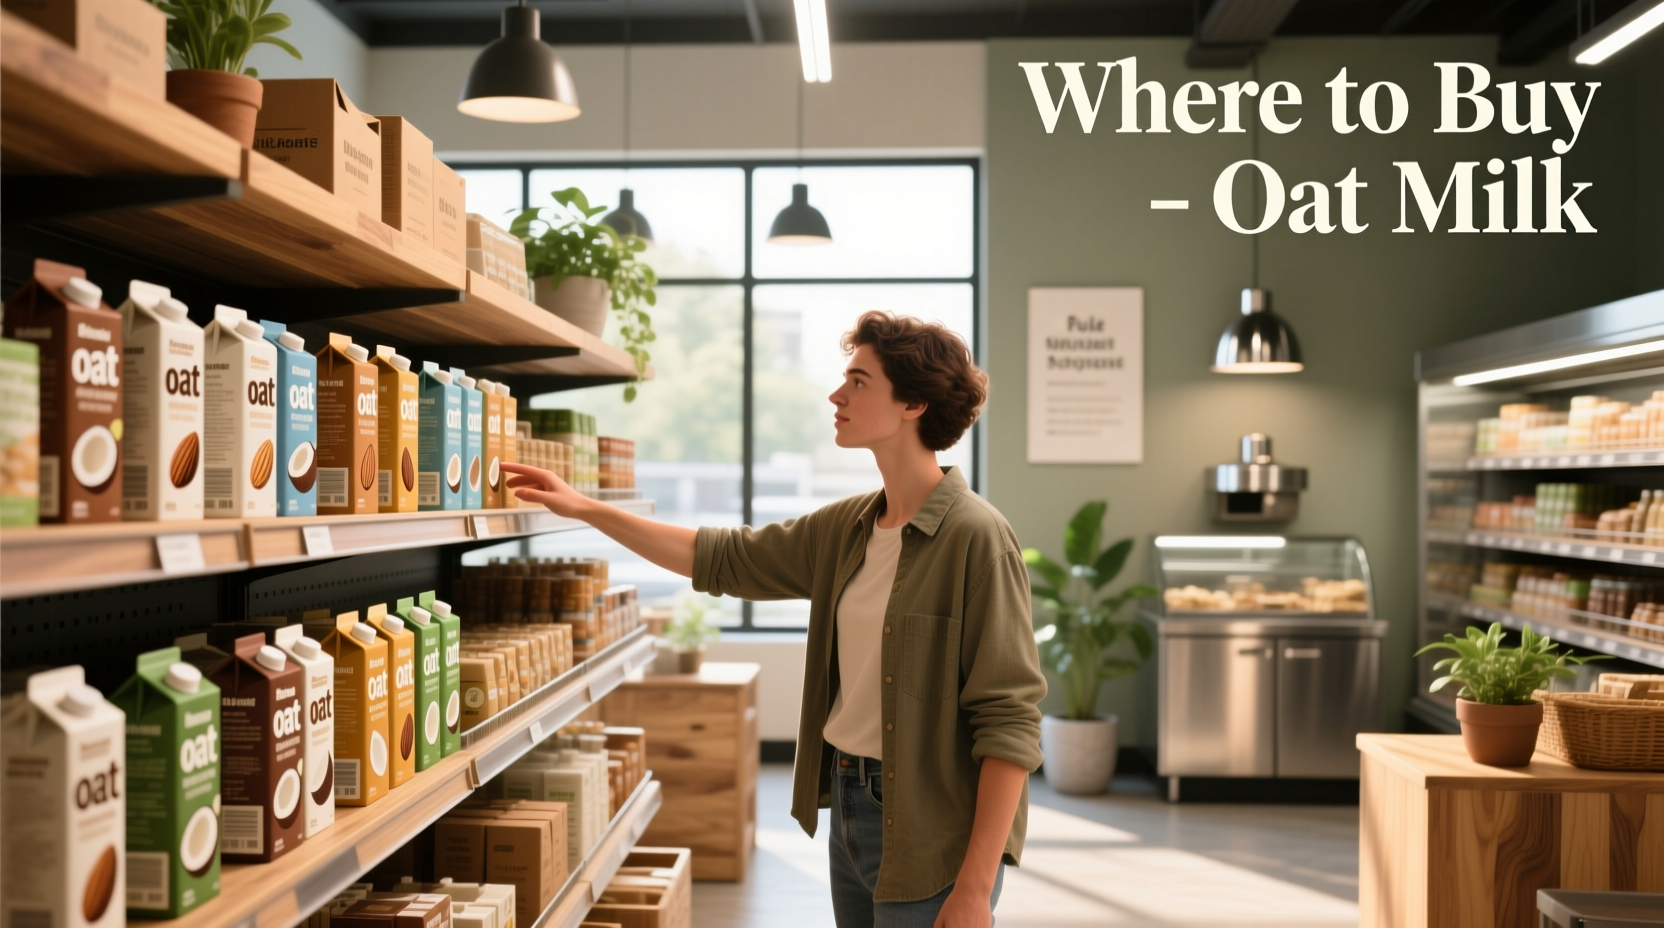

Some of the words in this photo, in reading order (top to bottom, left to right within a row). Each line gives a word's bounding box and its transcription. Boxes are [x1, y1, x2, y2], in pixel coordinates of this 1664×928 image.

[71, 345, 119, 387] oat
[165, 365, 200, 397] oat
[248, 377, 275, 407] oat
[289, 382, 315, 411] oat
[357, 389, 377, 417] oat
[368, 669, 388, 701] oat
[273, 698, 301, 739] oat
[310, 688, 332, 725] oat
[180, 723, 217, 773] oat
[76, 759, 118, 810] oat
